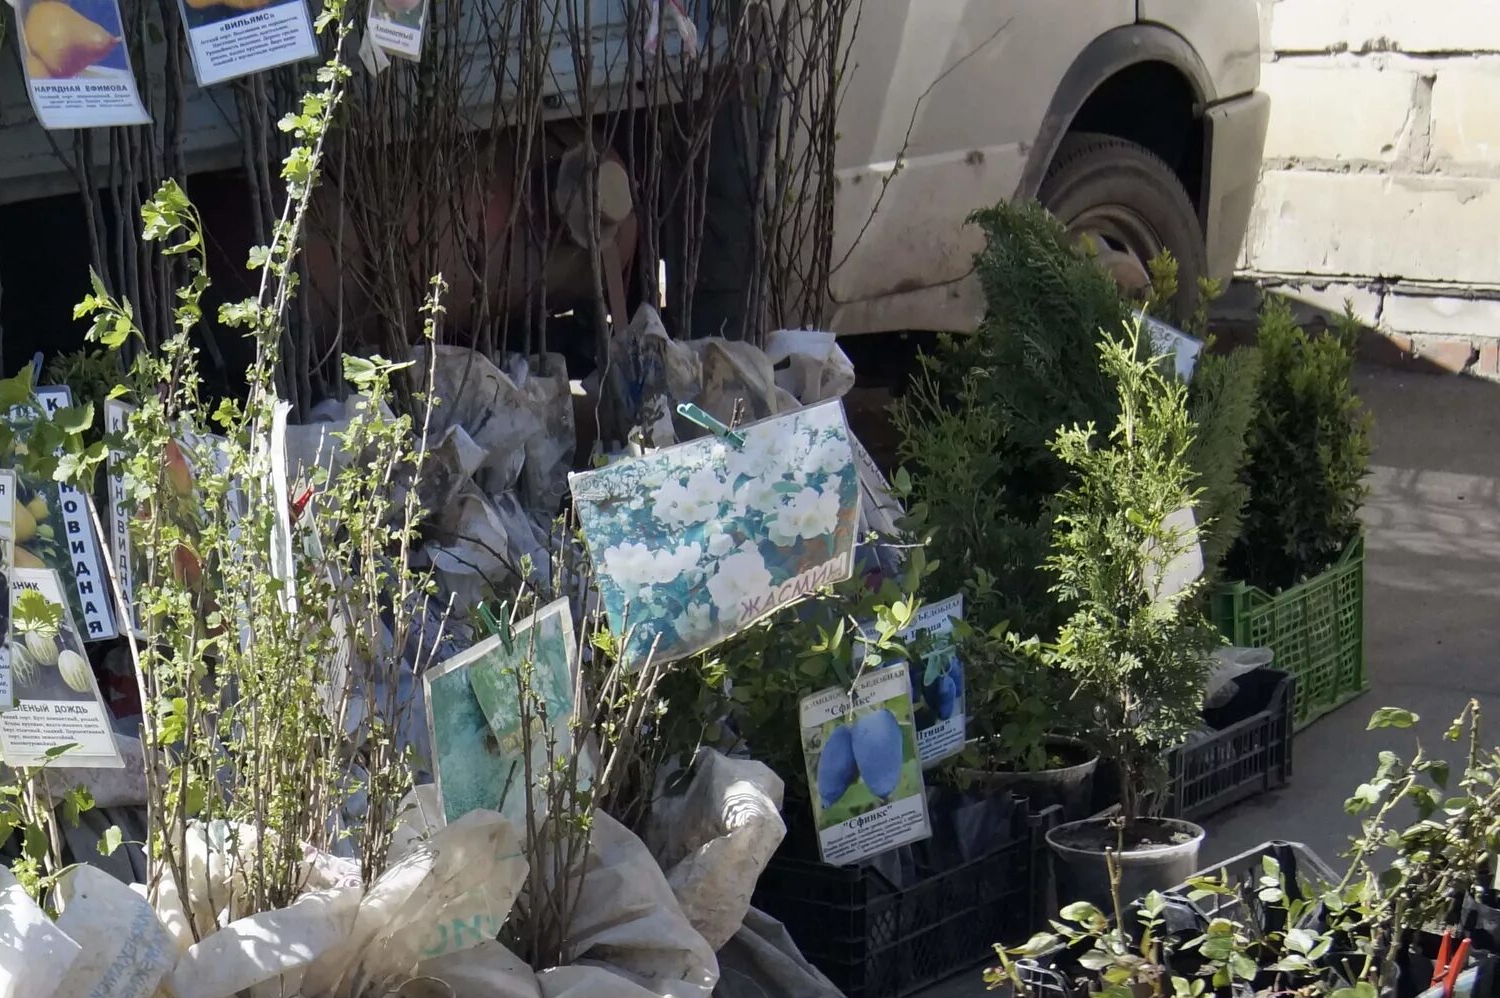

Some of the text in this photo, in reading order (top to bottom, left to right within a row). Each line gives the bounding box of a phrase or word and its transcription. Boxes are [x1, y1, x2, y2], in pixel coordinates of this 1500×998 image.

[220, 12, 275, 32] «ВИЛЬЯМС»
[85, 84, 128, 92] ЕФИМОВА
[741, 552, 848, 622] ЖАСМИН
[54, 704, 88, 714] ДОЖДЬ
[843, 805, 893, 829] "Сфинкс"
